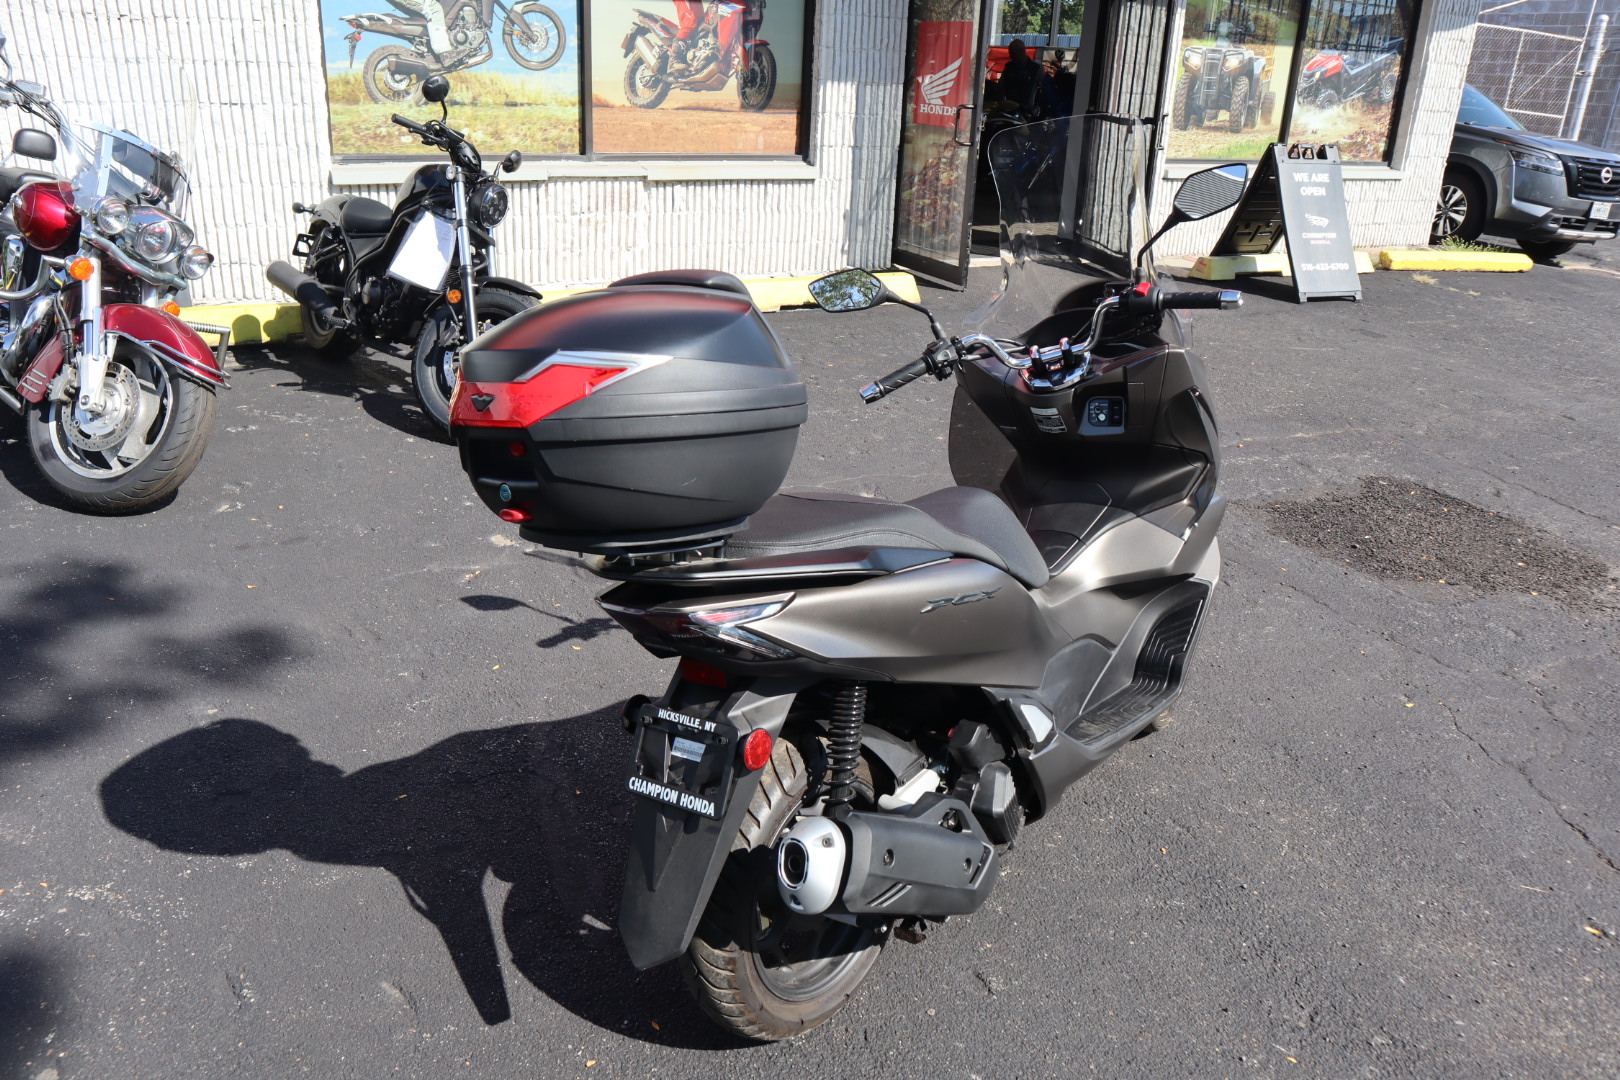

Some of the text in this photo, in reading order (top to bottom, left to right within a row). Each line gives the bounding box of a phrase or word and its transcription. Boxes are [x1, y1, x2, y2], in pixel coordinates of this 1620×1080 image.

[920, 104, 957, 116] HONDA
[1293, 172, 1330, 183] WE ARE
[1300, 187, 1326, 196] OPEN
[658, 709, 717, 732] HICKSVILLE, NY
[628, 776, 715, 817] CHAMPION HONDA
